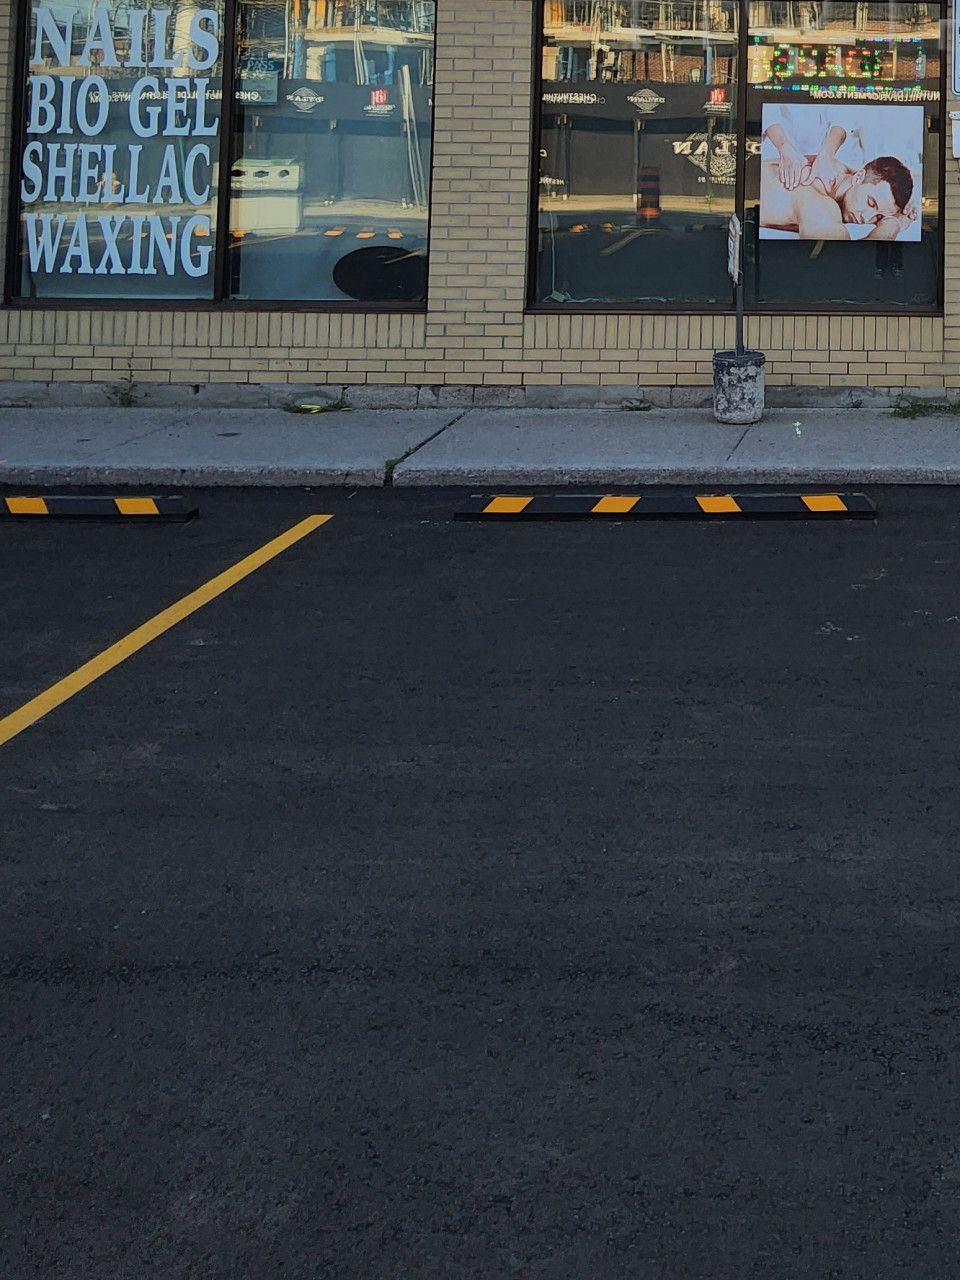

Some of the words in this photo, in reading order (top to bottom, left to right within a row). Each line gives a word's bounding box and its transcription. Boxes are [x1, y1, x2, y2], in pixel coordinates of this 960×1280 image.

[31, 6, 219, 70] NAILS
[27, 75, 110, 136] BIO
[129, 76, 219, 138] GEL
[20, 141, 211, 206] SHELLAC
[23, 212, 213, 278] WAXING
